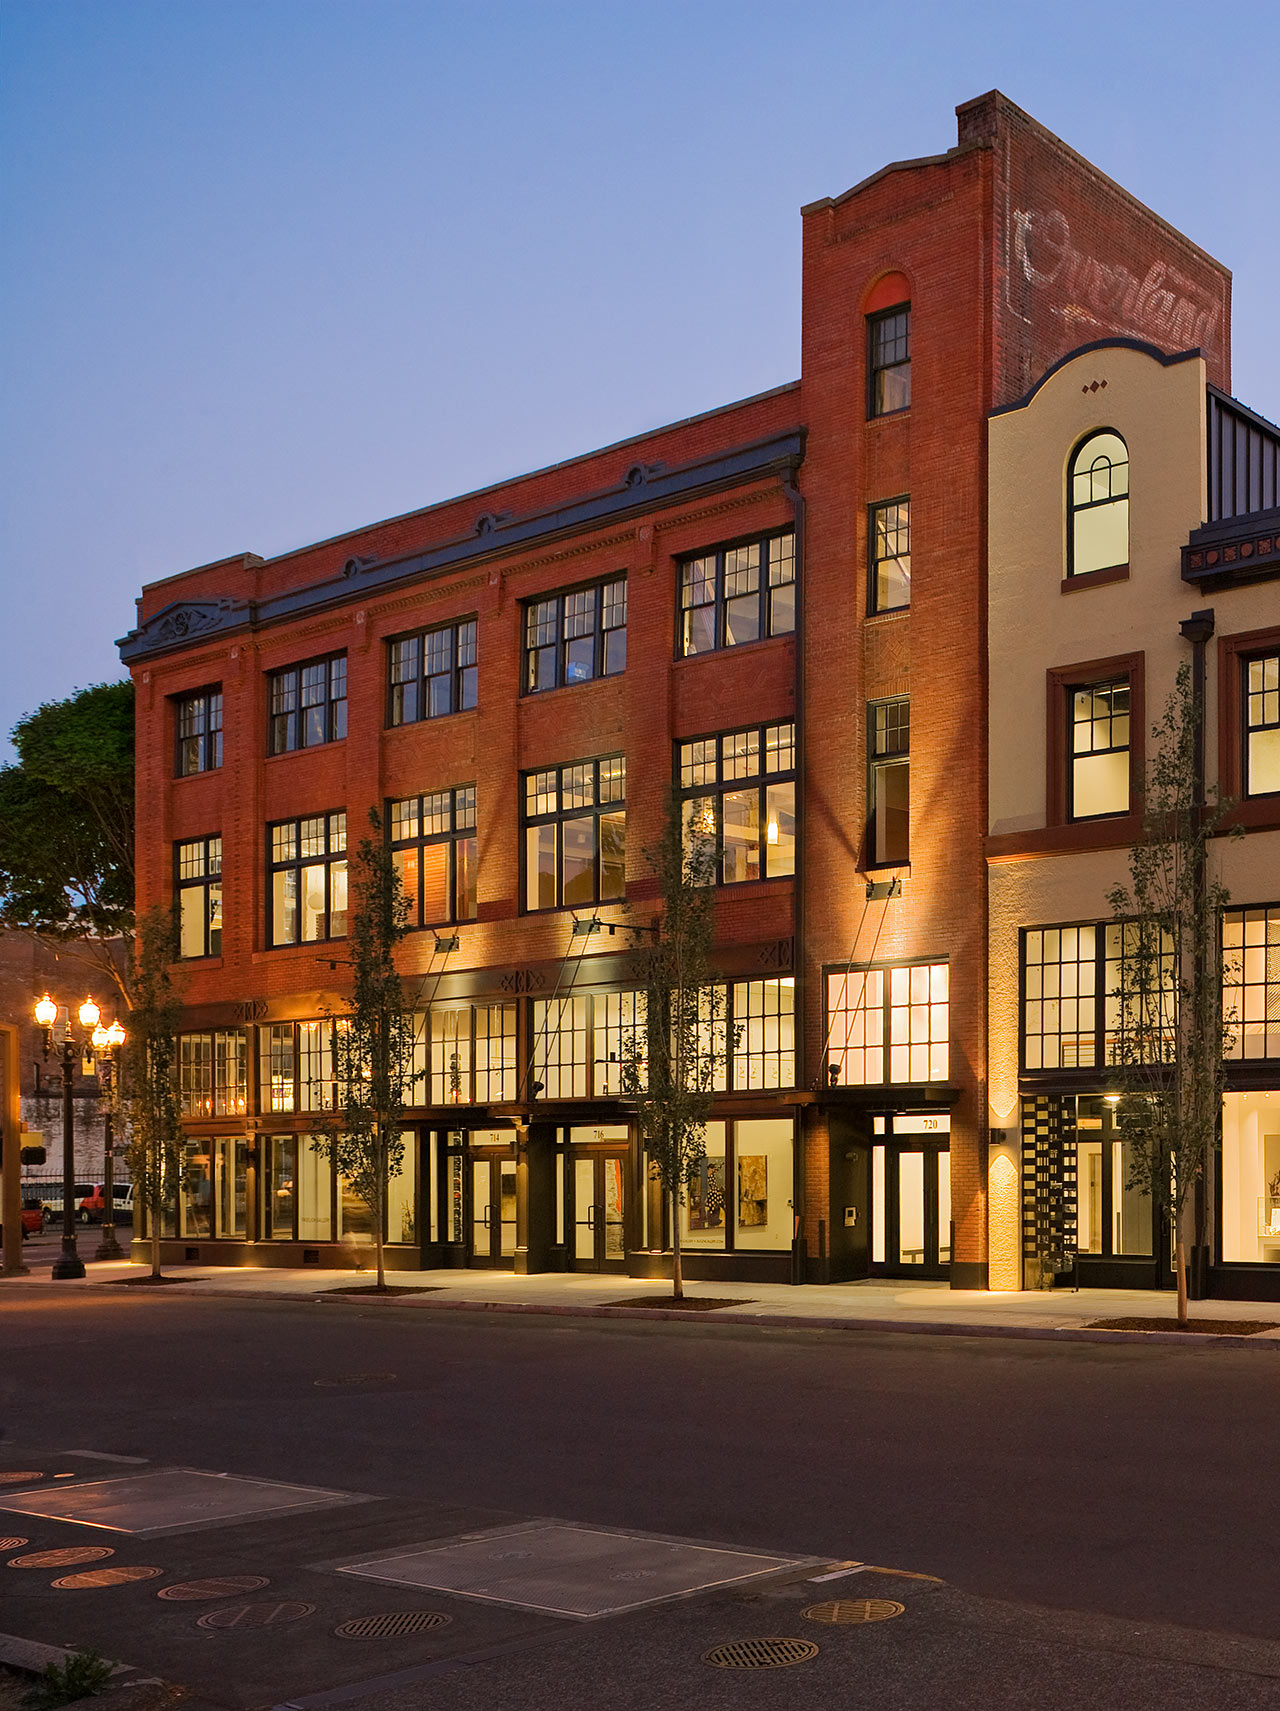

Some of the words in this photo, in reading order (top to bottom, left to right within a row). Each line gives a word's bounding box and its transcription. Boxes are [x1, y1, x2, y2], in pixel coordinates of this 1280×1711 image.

[923, 1119, 938, 1129] 720
[490, 1133, 500, 1143] 714
[593, 1130, 605, 1140] 716
